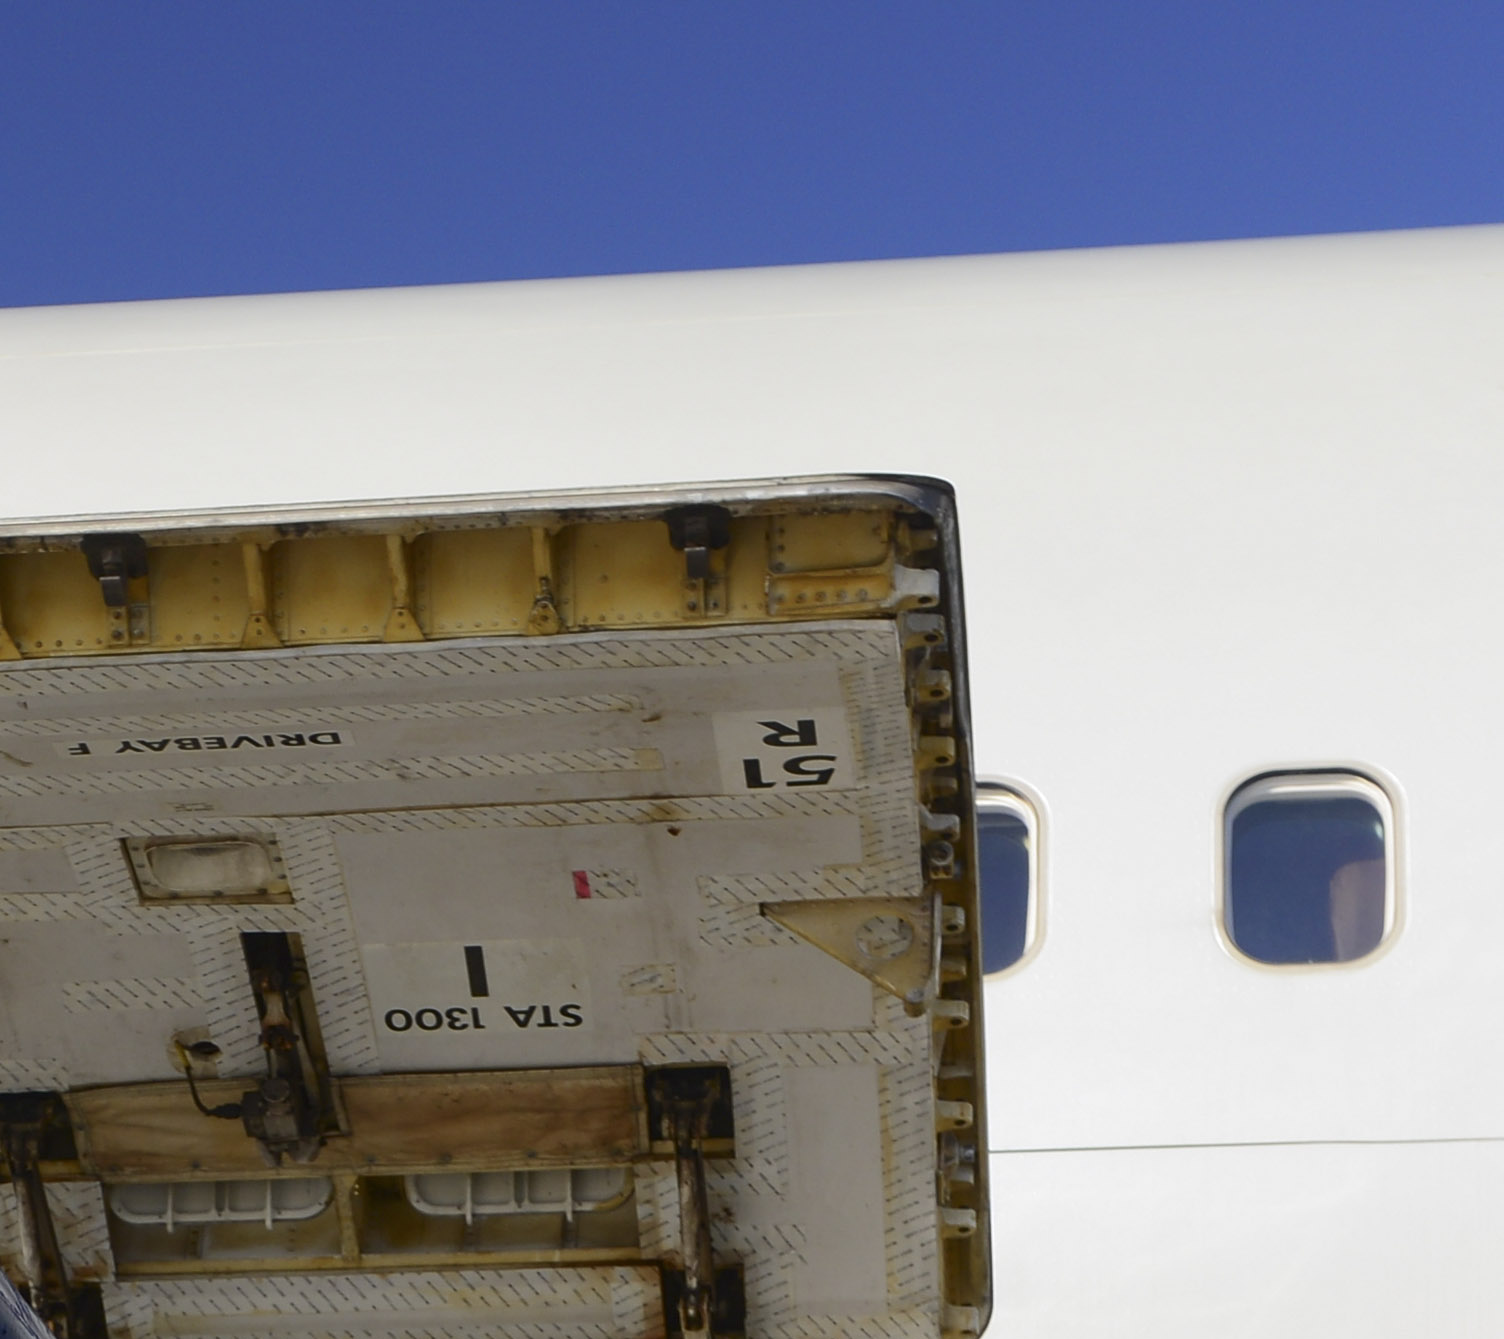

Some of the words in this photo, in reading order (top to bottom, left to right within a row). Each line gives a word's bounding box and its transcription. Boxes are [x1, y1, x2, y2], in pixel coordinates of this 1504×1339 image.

[115, 731, 342, 754] DRIVEBAY
[755, 719, 818, 747] R
[67, 742, 91, 756] F
[742, 754, 838, 789] 51
[384, 1006, 487, 1032] 1300
[503, 1003, 584, 1029] STA
